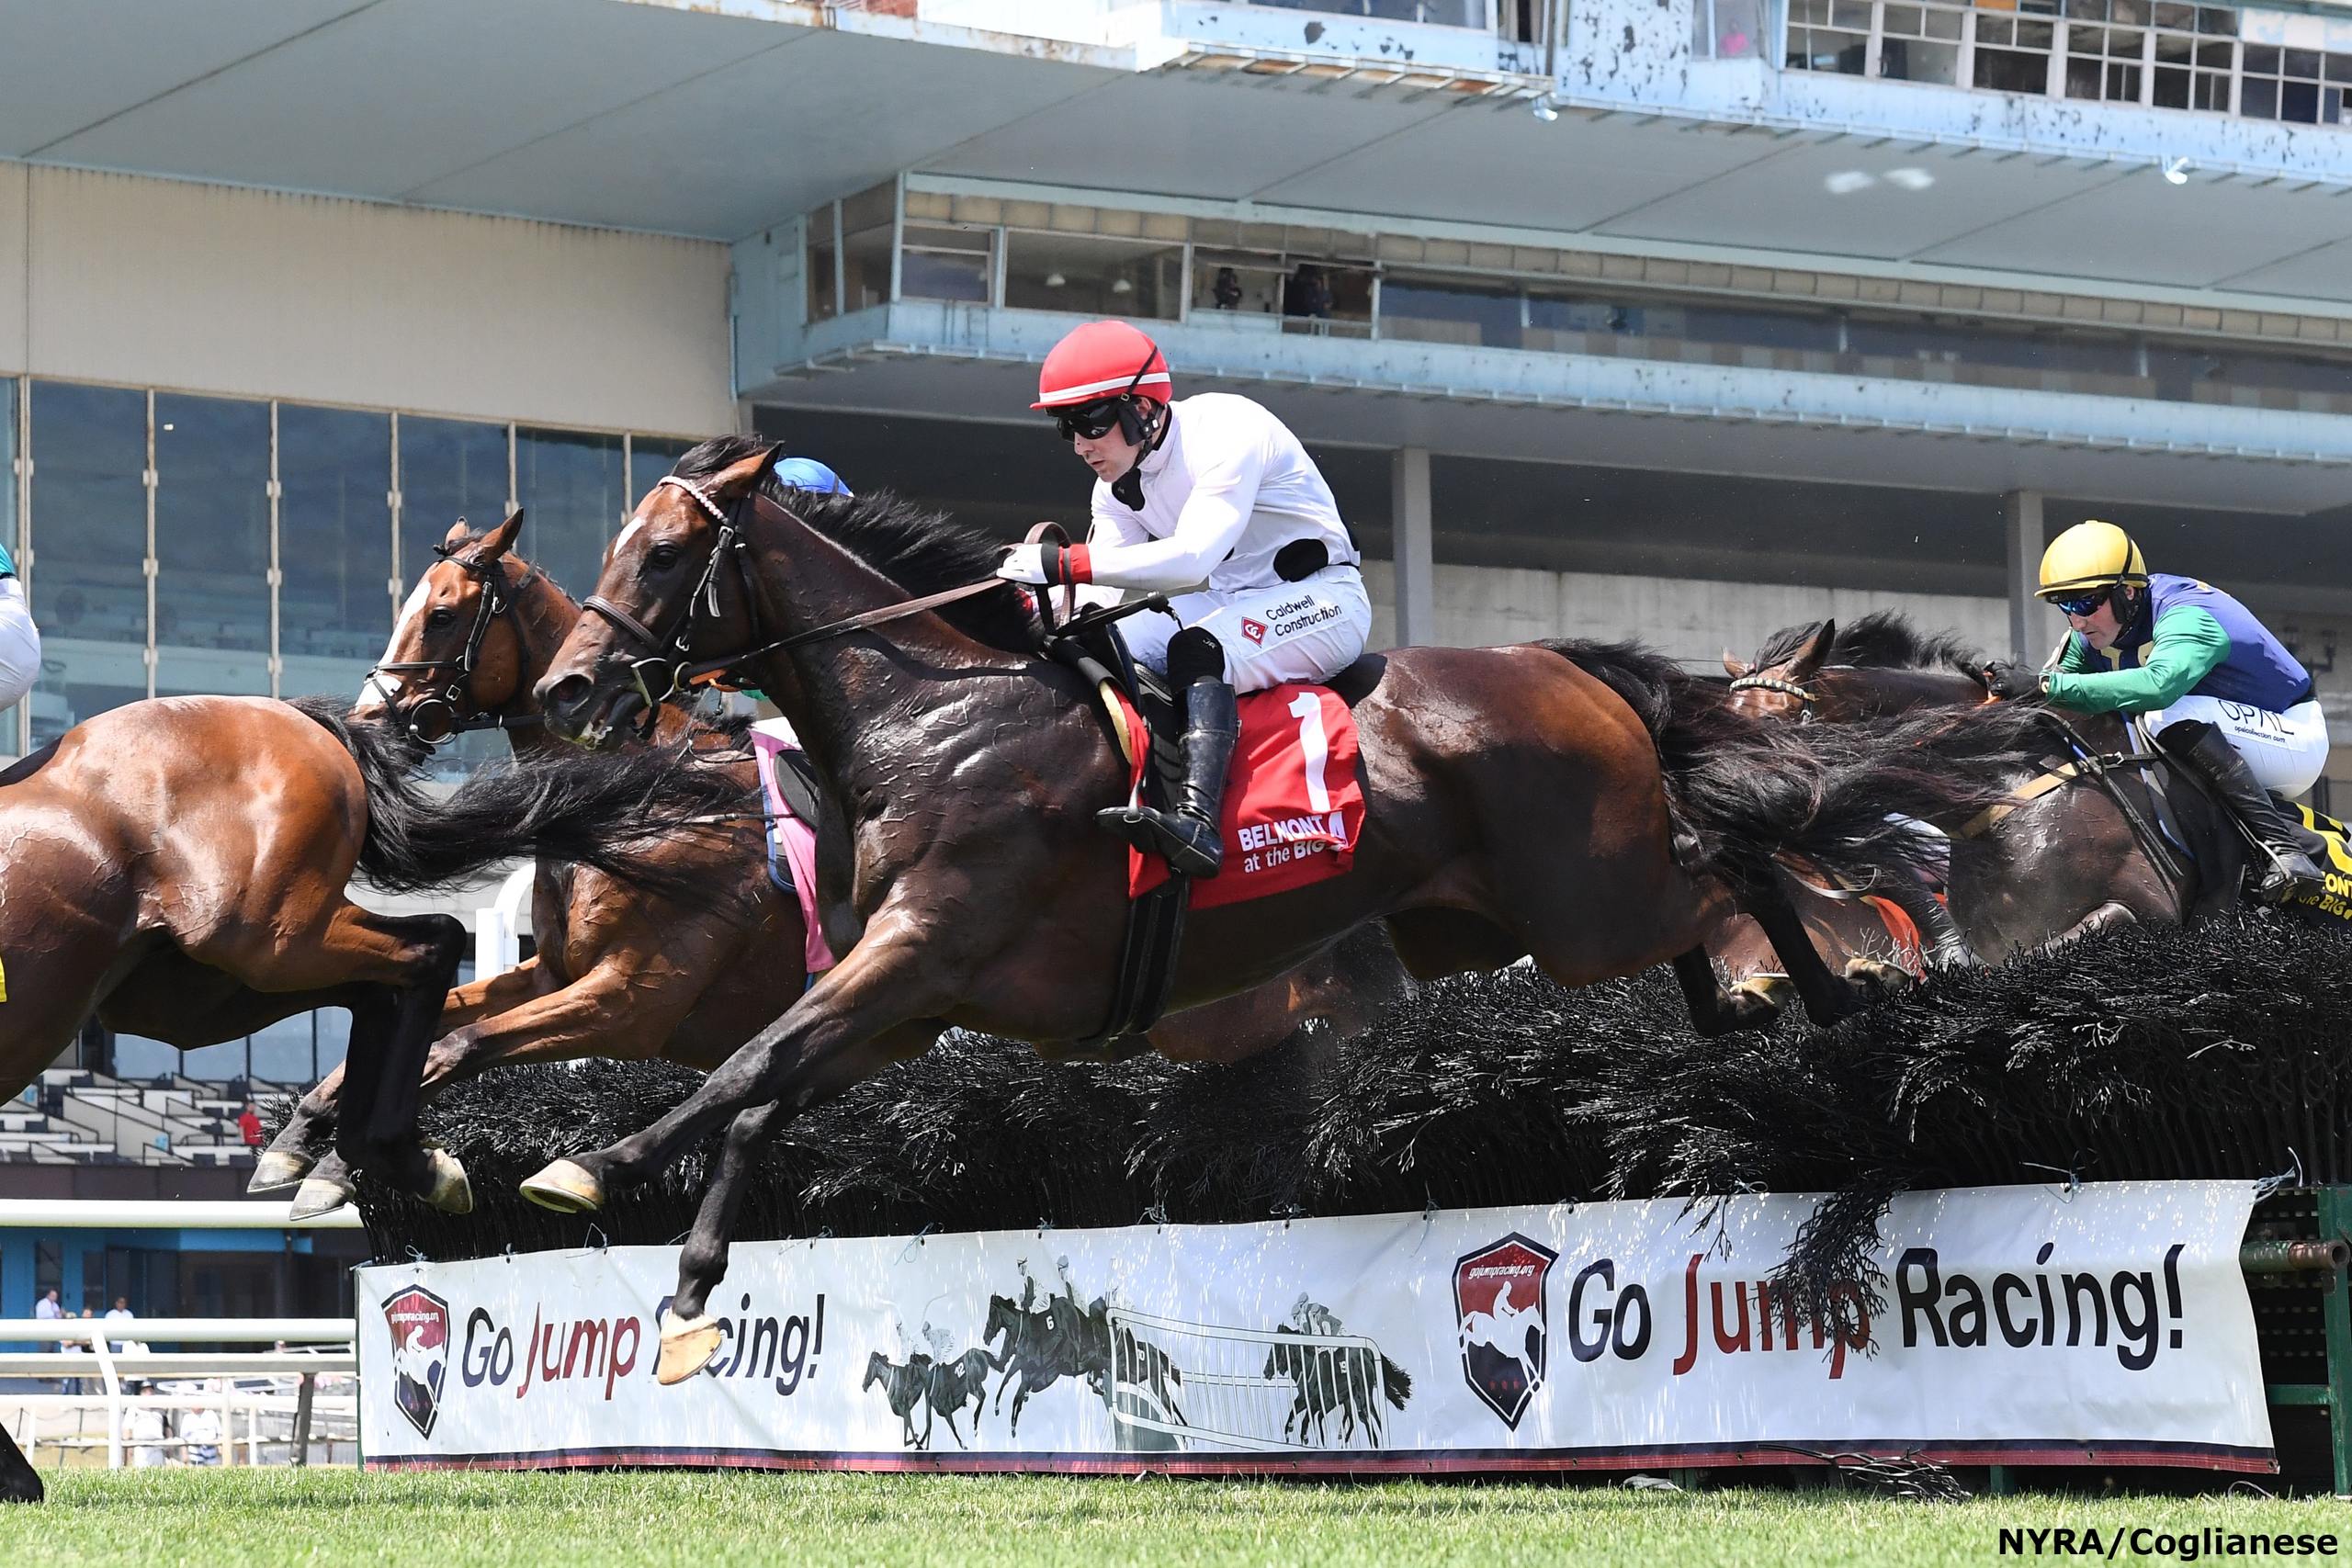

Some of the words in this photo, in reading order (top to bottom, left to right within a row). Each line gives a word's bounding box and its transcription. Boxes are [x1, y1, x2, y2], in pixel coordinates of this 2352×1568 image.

[1266, 595, 1315, 620] Caldwell
[1275, 605, 1342, 637] Construction
[1287, 691, 1331, 813] 1
[1238, 815, 1327, 852] BELMONT
[1244, 853, 1261, 873] at
[1266, 847, 1291, 867] the
[1294, 840, 1326, 860] BIG
[2319, 894, 2347, 916] BIG
[1468, 1263, 1536, 1280] gojumpracing.org
[1046, 1314, 1055, 1330] 6
[1567, 1258, 1651, 1362] Go
[1896, 1242, 2186, 1371] Racing!
[462, 1306, 514, 1387] Go
[516, 1302, 640, 1401] Jump
[651, 1293, 825, 1396] cing!
[955, 1361, 966, 1378] 12
